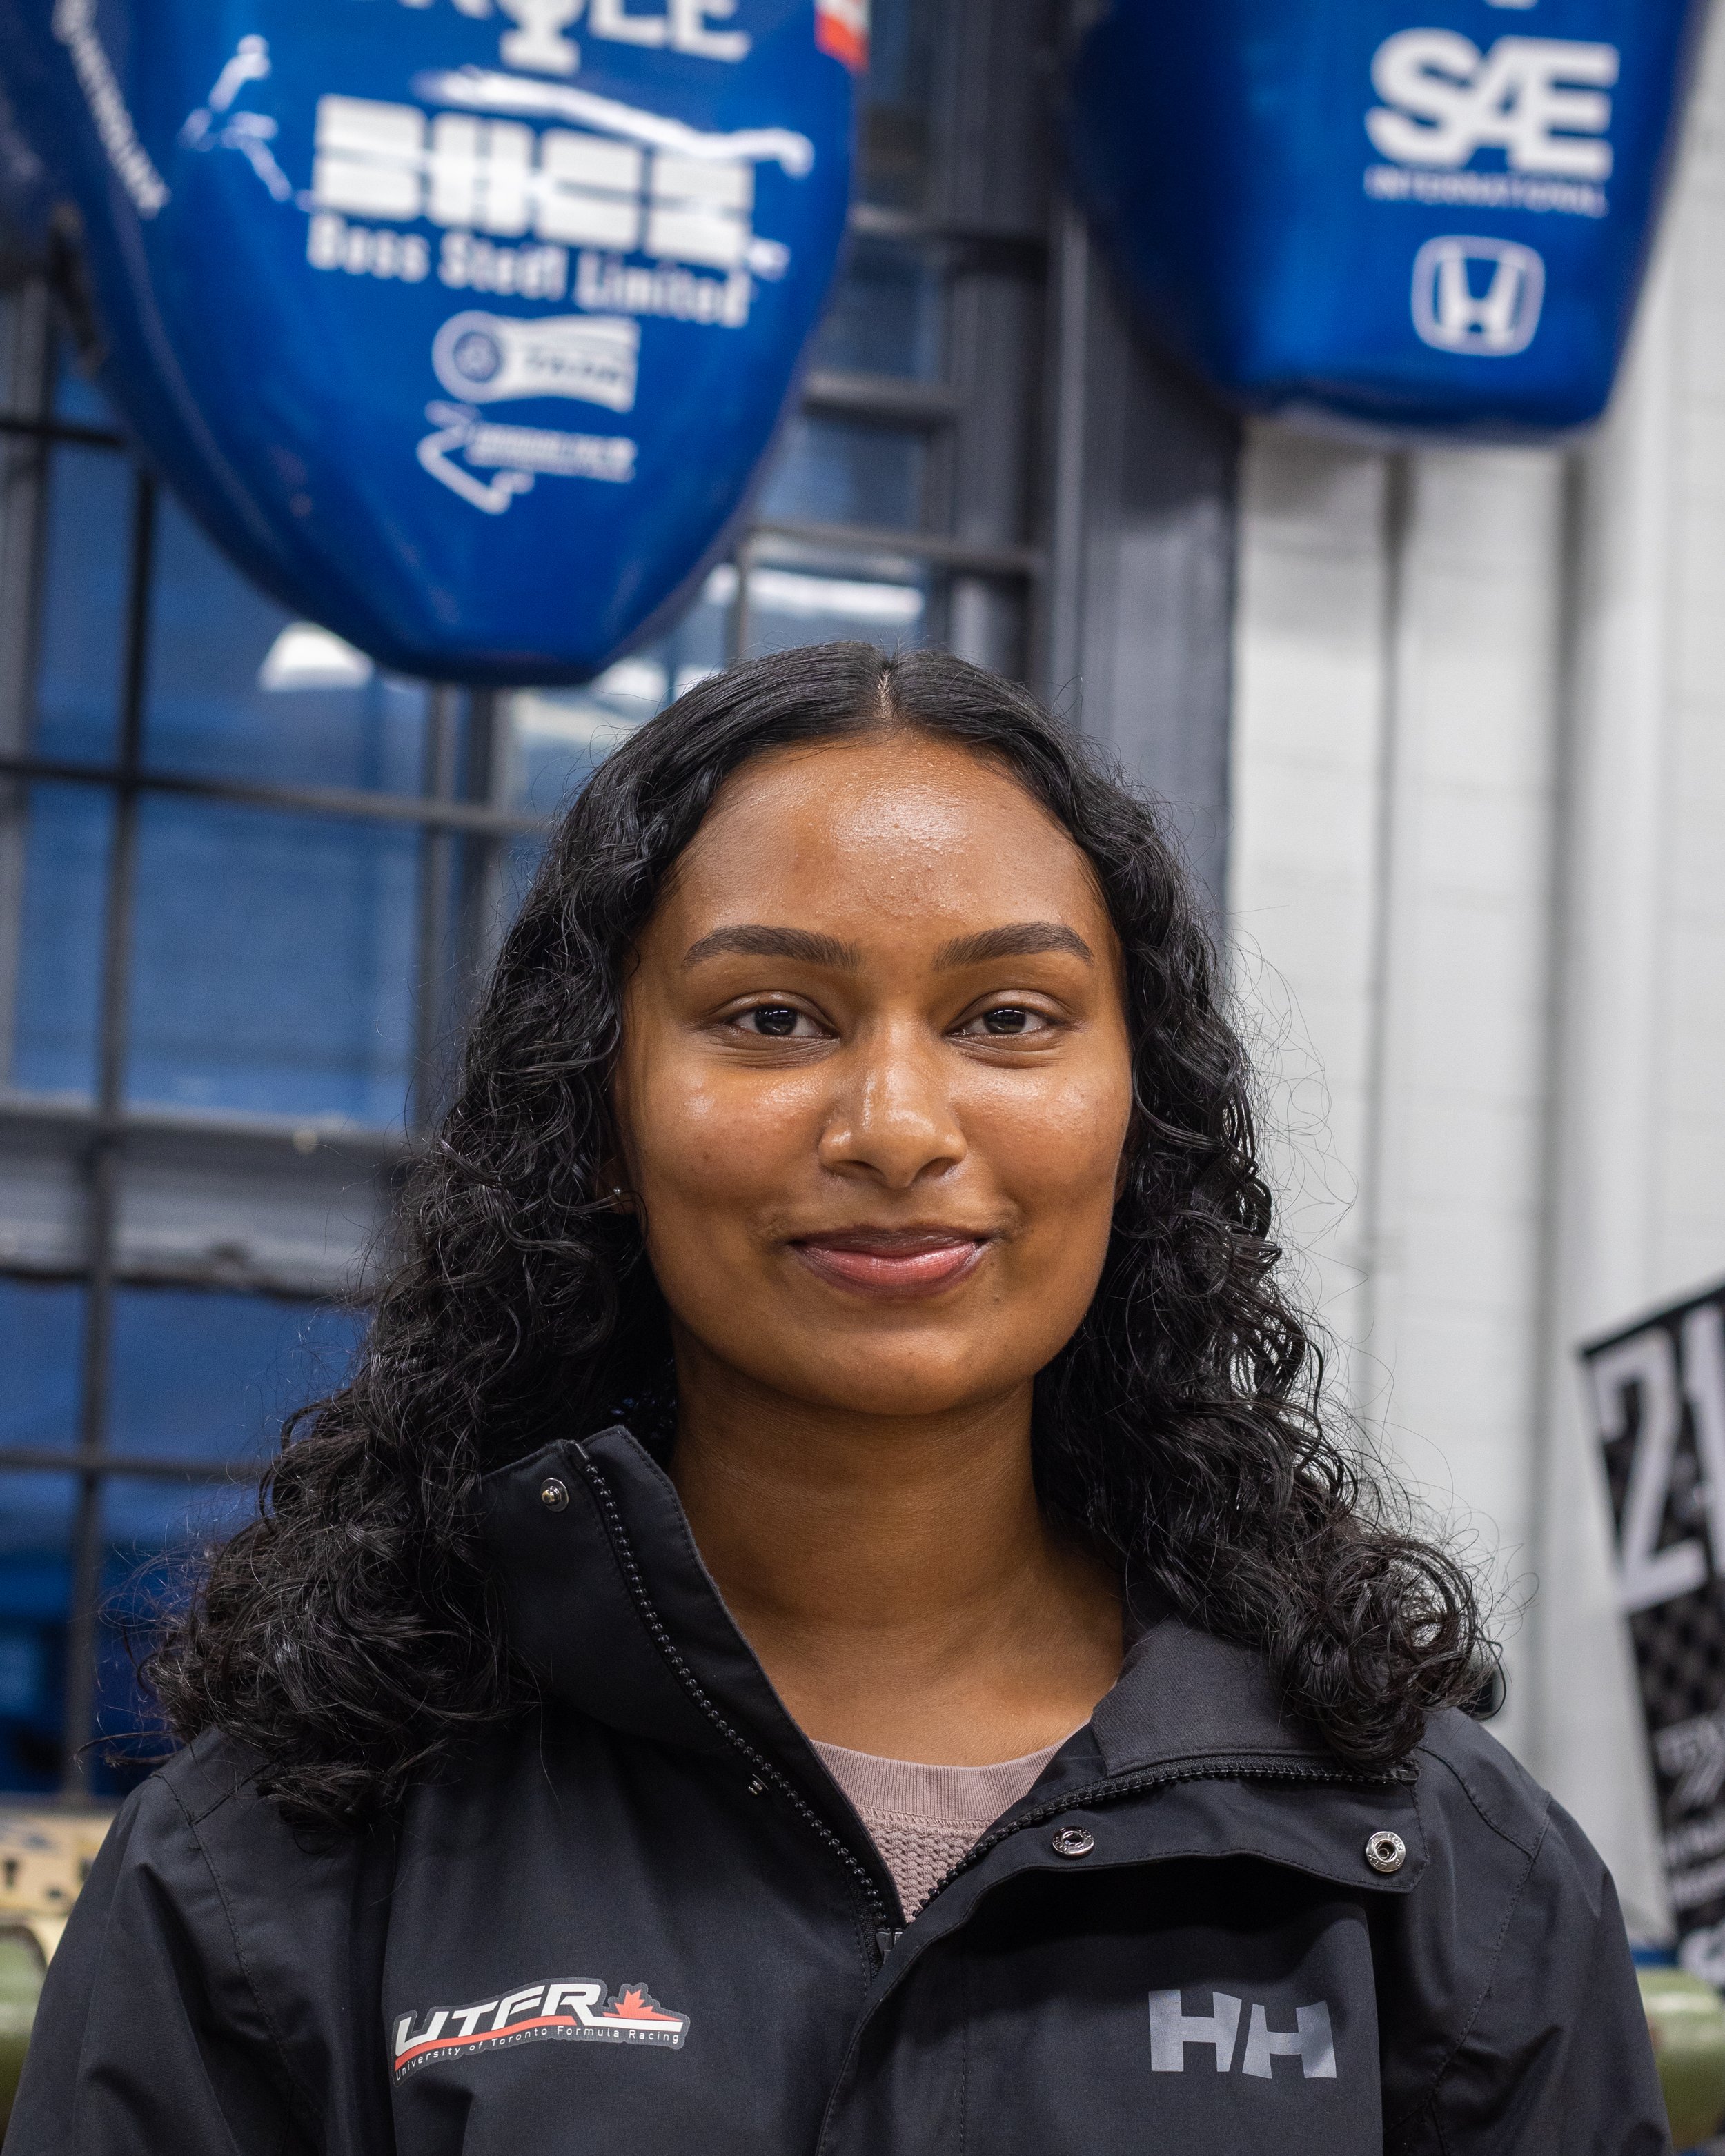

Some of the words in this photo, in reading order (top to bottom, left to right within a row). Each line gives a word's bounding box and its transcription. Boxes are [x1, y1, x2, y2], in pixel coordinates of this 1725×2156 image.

[1365, 28, 1619, 181] SAE
[395, 1984, 602, 2057] UTFR
[395, 2046, 462, 2081] University
[469, 2040, 484, 2053] of
[491, 2026, 548, 2047] Toronto
[557, 2026, 620, 2039] Formula
[629, 2028, 680, 2045] Racing
